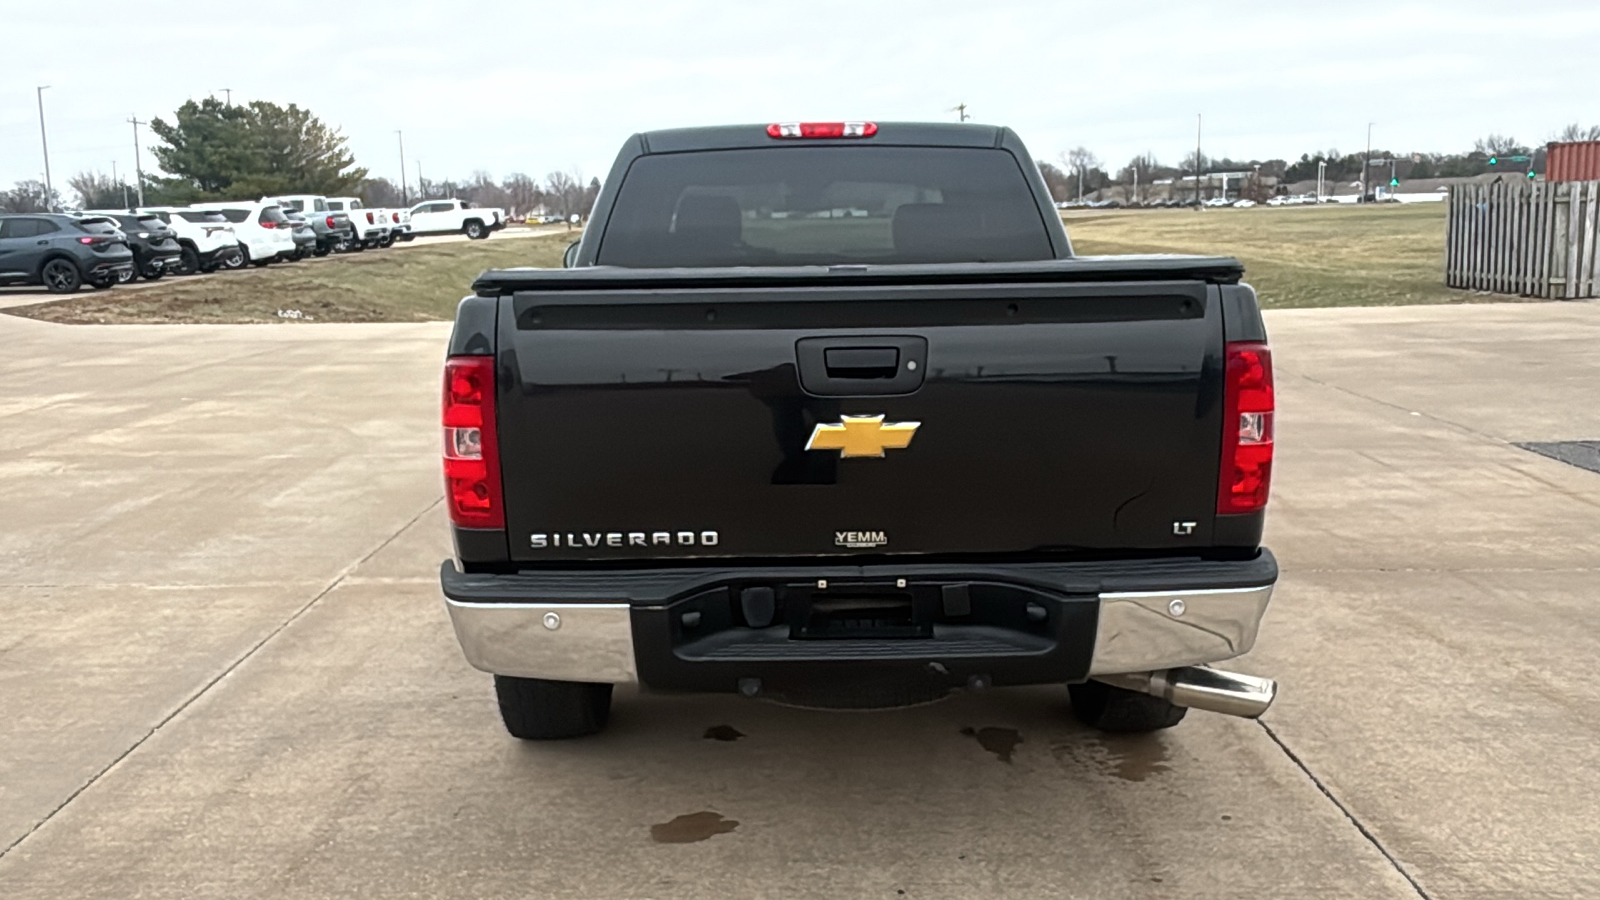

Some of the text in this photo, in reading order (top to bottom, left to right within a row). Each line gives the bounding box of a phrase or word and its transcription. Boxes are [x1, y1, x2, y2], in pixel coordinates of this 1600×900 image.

[1173, 521, 1197, 535] LT
[530, 531, 719, 548] SILVERADO
[835, 531, 885, 543] YEMM
